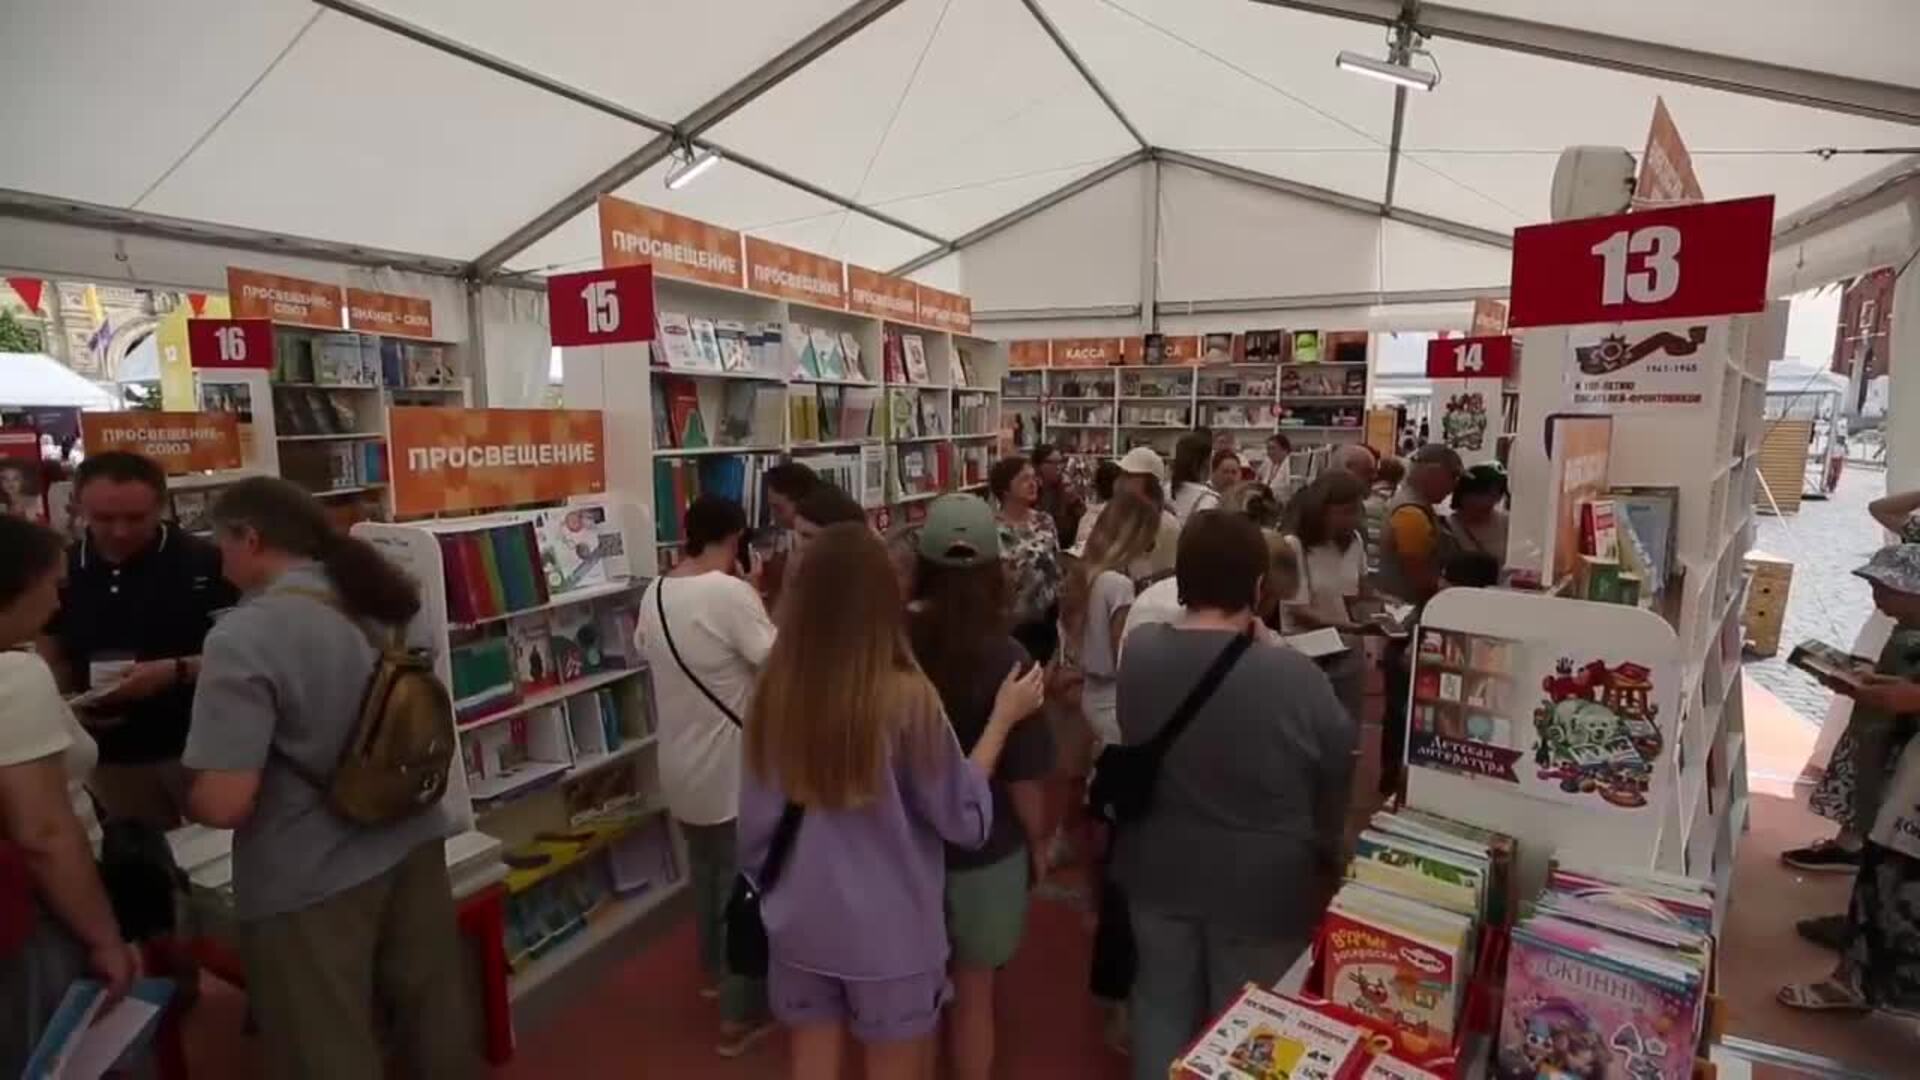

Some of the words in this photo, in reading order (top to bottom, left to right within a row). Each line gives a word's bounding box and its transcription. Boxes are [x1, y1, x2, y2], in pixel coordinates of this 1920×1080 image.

[611, 229, 737, 275] ПРОСВЕЩЕНИЕ
[1591, 225, 1682, 305] 13
[754, 263, 841, 298] ПРОСВЕЩЕНИЕ
[581, 280, 620, 334] 15
[214, 326, 247, 361] 16
[1065, 347, 1105, 359] КАССА
[1453, 343, 1483, 373] 14
[145, 442, 192, 456] СОЮЗ
[407, 443, 595, 471] ПРОСВЕЩЕНИЕ
